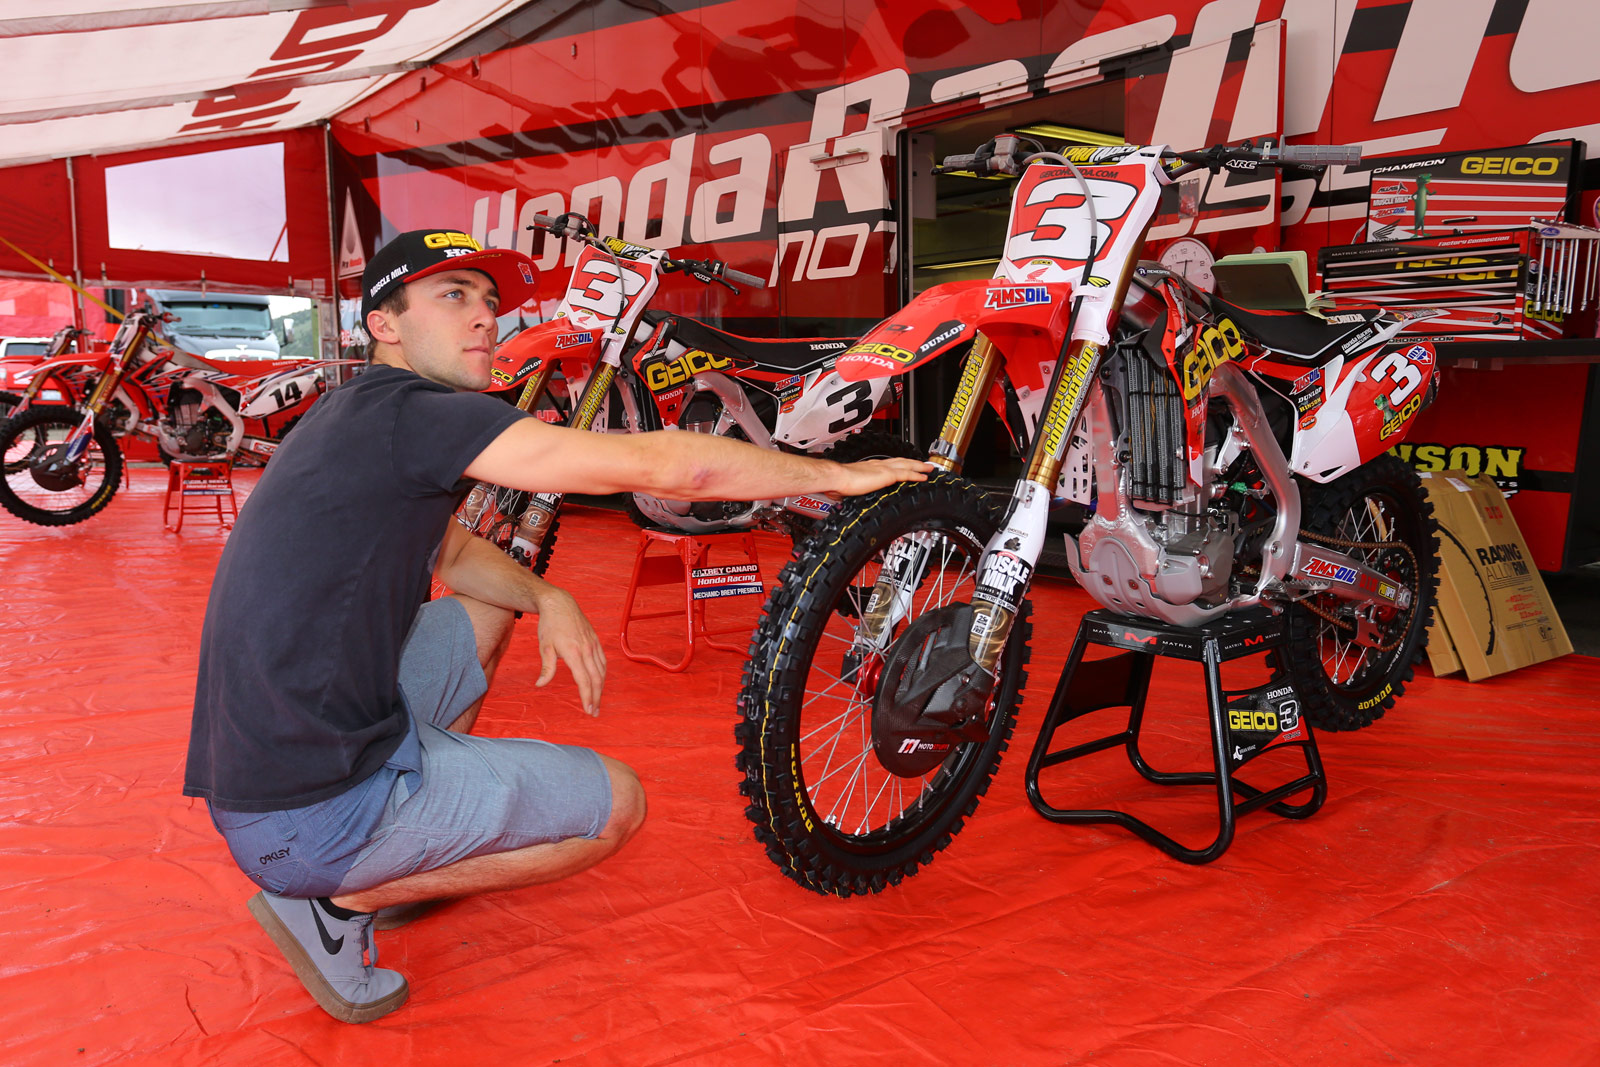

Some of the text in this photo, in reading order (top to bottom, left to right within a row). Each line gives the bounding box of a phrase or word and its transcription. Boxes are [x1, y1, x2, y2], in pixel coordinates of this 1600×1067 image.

[1226, 159, 1257, 170] ARC
[1373, 158, 1446, 175] CHAMPION
[1460, 156, 1560, 176] GEICO
[1006, 178, 1138, 262] 3
[424, 232, 483, 250] GEI
[369, 264, 409, 297] MUSCLE MILK
[567, 259, 648, 318] 3
[986, 286, 1052, 311] AMSOIL
[556, 332, 593, 349] AMSOIL
[809, 342, 847, 351] HONDA
[919, 323, 966, 352] DUNLOP
[838, 354, 895, 370] HONDA
[845, 342, 915, 364] GEICO
[516, 359, 543, 377] DUNLOP
[774, 374, 801, 391] AMSOIL
[1289, 368, 1320, 395] AMSOIL
[1370, 352, 1422, 406] 3
[269, 381, 302, 408] 14
[659, 388, 684, 402] HONDA
[1298, 386, 1323, 404] DUNLOP
[826, 380, 873, 434] 3
[1380, 394, 1421, 441] GEICO
[1387, 444, 1522, 477] NSON
[792, 495, 832, 514] AMSOI
[1475, 543, 1523, 567] RACING
[726, 565, 758, 573] CANARD
[984, 554, 1029, 584] MUSCLE
[1303, 558, 1356, 584] AMSOIL
[697, 577, 726, 585] Honda
[982, 569, 1019, 596] MILK
[1092, 628, 1120, 637] MATRIX
[1162, 640, 1193, 649] MATRIX
[1224, 642, 1243, 650] MATRIX
[1264, 632, 1281, 640] MATRIX
[1266, 685, 1294, 700] HONDA
[1357, 682, 1393, 710] DUNLOP
[1228, 710, 1278, 731] GEICO
[1279, 699, 1299, 732] 3
[790, 742, 815, 834] DUNLOP
[259, 847, 291, 866] OAKLEY
